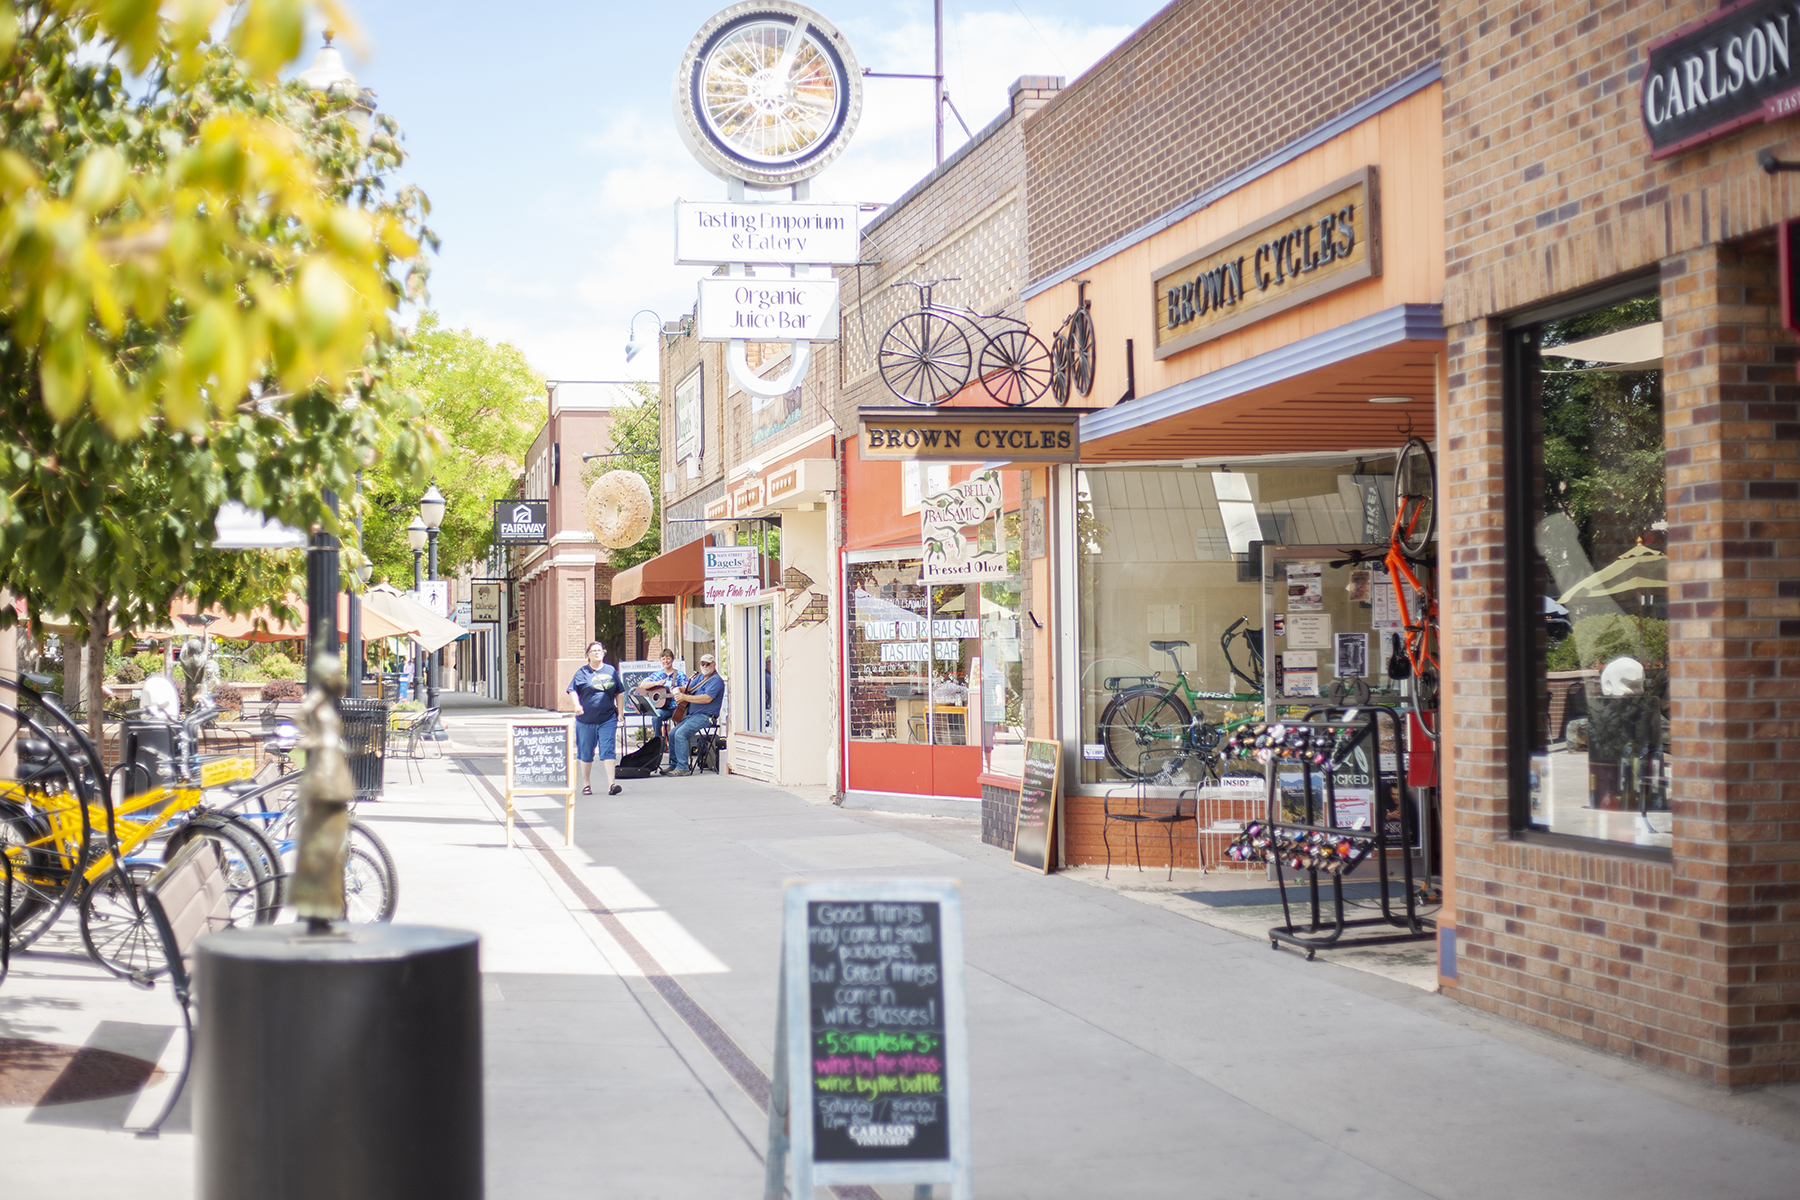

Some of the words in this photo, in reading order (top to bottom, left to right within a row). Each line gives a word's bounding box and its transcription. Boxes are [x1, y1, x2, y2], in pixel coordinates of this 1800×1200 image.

[1648, 14, 1790, 125] CARLSON
[694, 210, 756, 232] Tasting
[760, 212, 844, 233] Emporium
[732, 234, 744, 249] &
[748, 234, 807, 254] Eatery
[1166, 256, 1244, 330] BROWN
[1254, 204, 1354, 291] CYCLES
[735, 286, 806, 309] Organic
[730, 310, 774, 328] Juice
[779, 311, 812, 328] Bar
[869, 428, 962, 448] BROWN
[974, 430, 1071, 448] CYCLES
[964, 484, 996, 497] BELLA
[928, 507, 980, 522] BALSAMIC
[501, 523, 546, 533] FAIRWAY
[707, 553, 742, 569] Bagels
[928, 562, 971, 576] Pressed
[974, 561, 1004, 572] Olive
[726, 584, 744, 597] Photo
[745, 584, 758, 597] Art
[866, 622, 896, 640] OLIVE
[900, 622, 917, 639] OIL
[920, 623, 928, 638] &
[932, 620, 993, 638] BALSAMC
[882, 644, 929, 661] TASTING
[935, 642, 958, 660] BAR
[513, 728, 529, 736] CAN
[514, 737, 522, 746] IF
[522, 737, 538, 745] YOUR
[538, 735, 555, 744] OLIVE
[519, 747, 526, 755] is
[555, 746, 562, 757] by
[818, 904, 866, 924] Good
[810, 926, 840, 952] may
[841, 925, 879, 944] come
[880, 922, 892, 942] in
[895, 924, 932, 944] small
[810, 962, 836, 983] but
[842, 961, 886, 982] Great
[834, 986, 878, 1004] come
[880, 985, 896, 1005] in
[822, 1004, 862, 1024] wine
[866, 998, 936, 1028] glasses!
[826, 1032, 839, 1054] 5
[840, 1031, 900, 1059] samples
[900, 1032, 915, 1050] for
[816, 1054, 853, 1074] wine
[853, 1054, 874, 1080] by
[875, 1054, 897, 1074] the
[899, 1054, 939, 1076] glass
[816, 1076, 854, 1092] wine
[856, 1075, 878, 1102] by
[878, 1074, 898, 1092] the
[900, 1073, 943, 1094] bottle
[818, 1100, 874, 1120] Saturday
[848, 1125, 915, 1138] CARLSON
[856, 1138, 910, 1146] VINEYARDS
